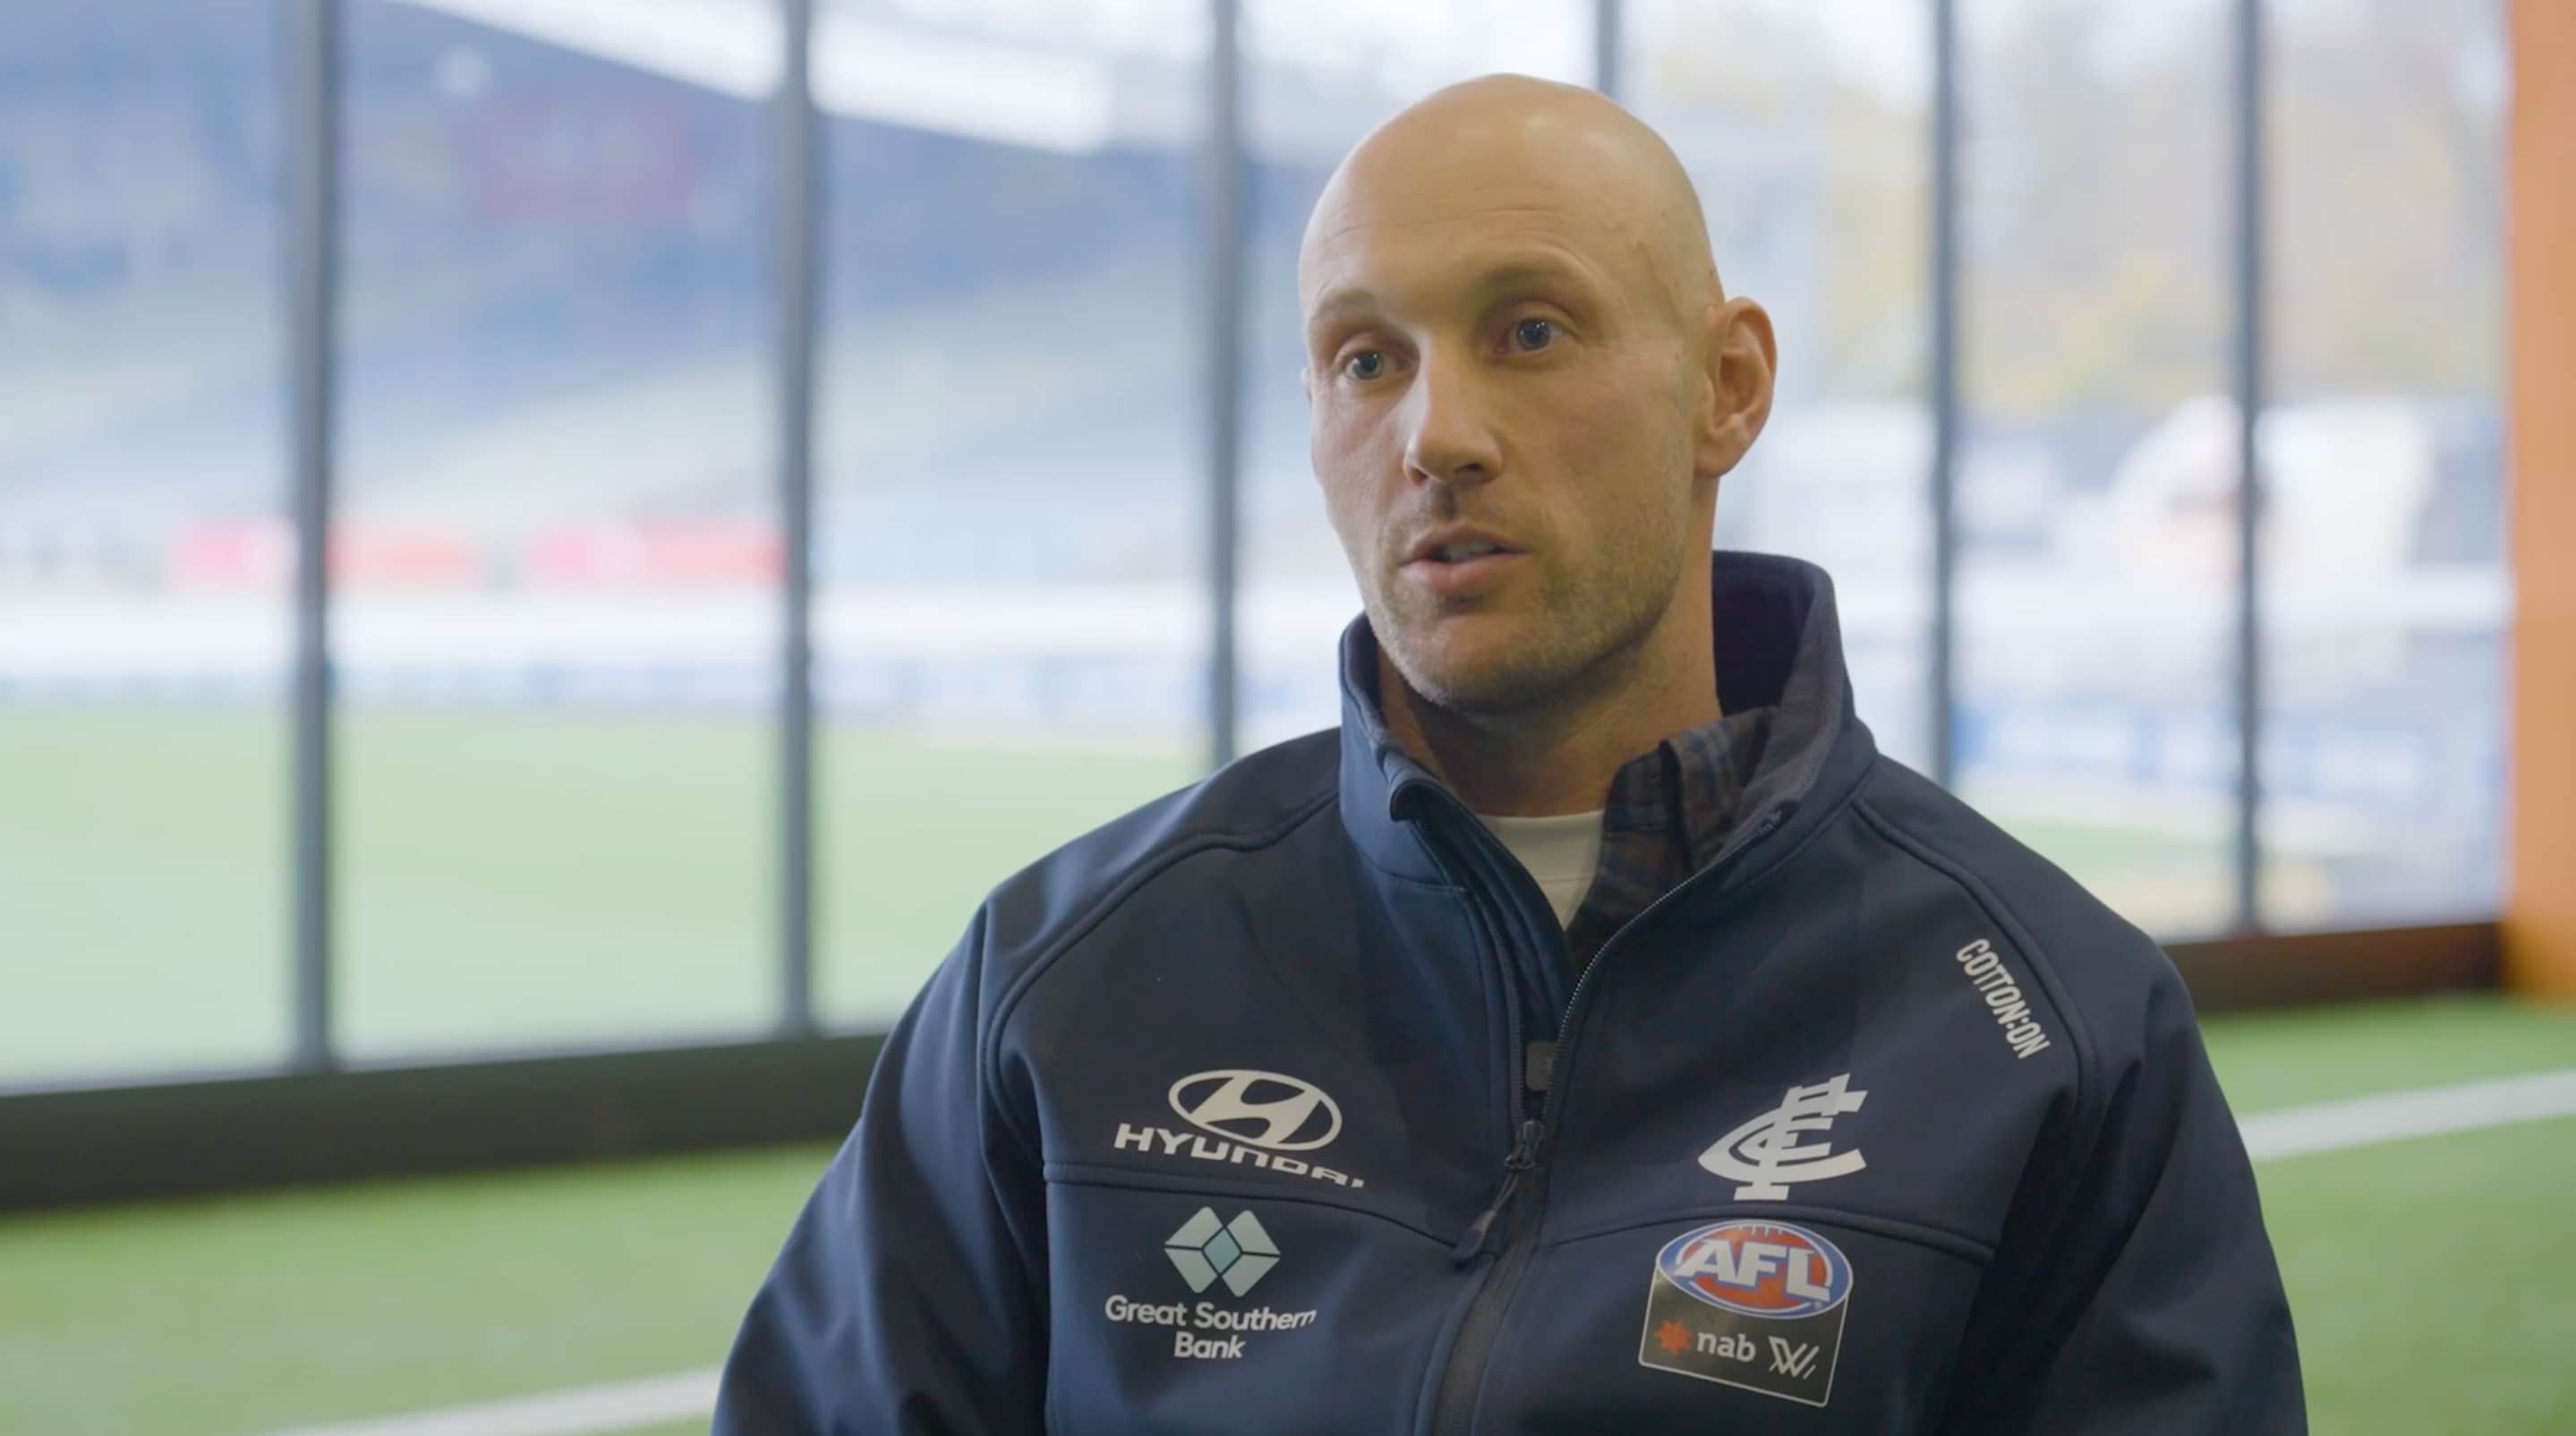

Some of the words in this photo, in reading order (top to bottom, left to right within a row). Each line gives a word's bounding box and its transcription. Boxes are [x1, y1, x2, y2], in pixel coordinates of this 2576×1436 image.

[1113, 1124, 1365, 1188] HYUNDAI
[1674, 1240, 1830, 1302] AFL
[1105, 1295, 1188, 1327] Great
[1194, 1302, 1317, 1330] Southern
[1174, 1332, 1246, 1359] Bank
[1697, 1332, 1756, 1363] nab
